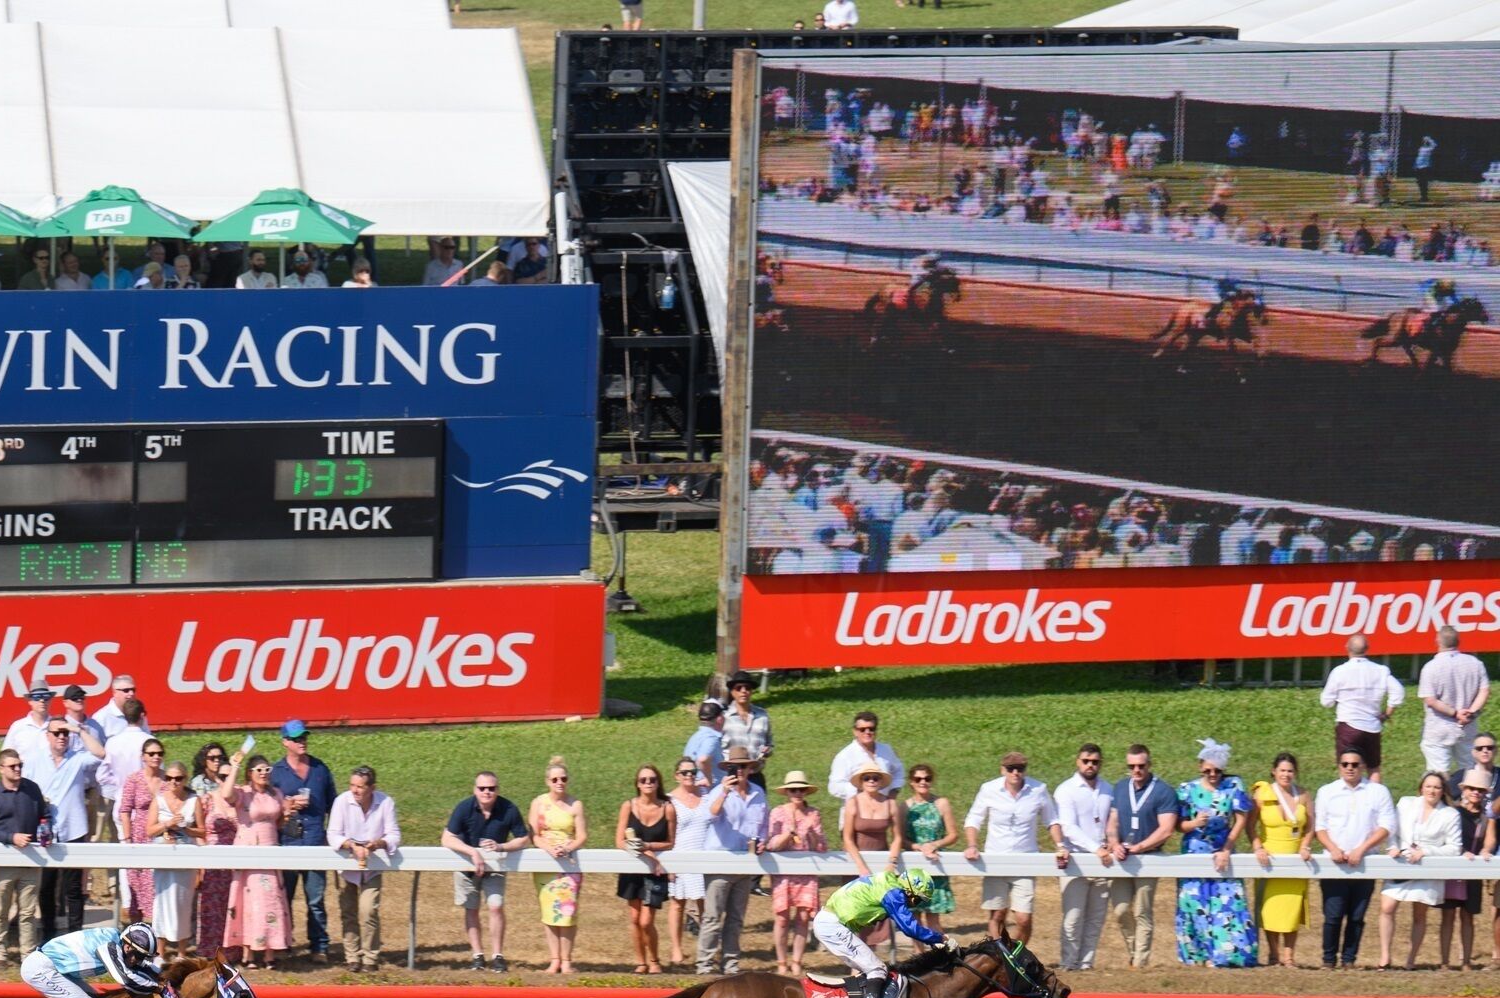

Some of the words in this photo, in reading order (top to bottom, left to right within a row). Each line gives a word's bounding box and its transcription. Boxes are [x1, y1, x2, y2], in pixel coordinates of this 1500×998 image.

[91, 212, 126, 223] TAB
[259, 218, 292, 228] TAB
[160, 318, 500, 389] RACING
[61, 436, 97, 460] 4TH
[145, 434, 182, 459] 5TH
[322, 431, 395, 455] TIME
[288, 506, 392, 531] TRACK
[835, 588, 1112, 646] Ladbrokes
[167, 616, 535, 693] Ladbrokes
